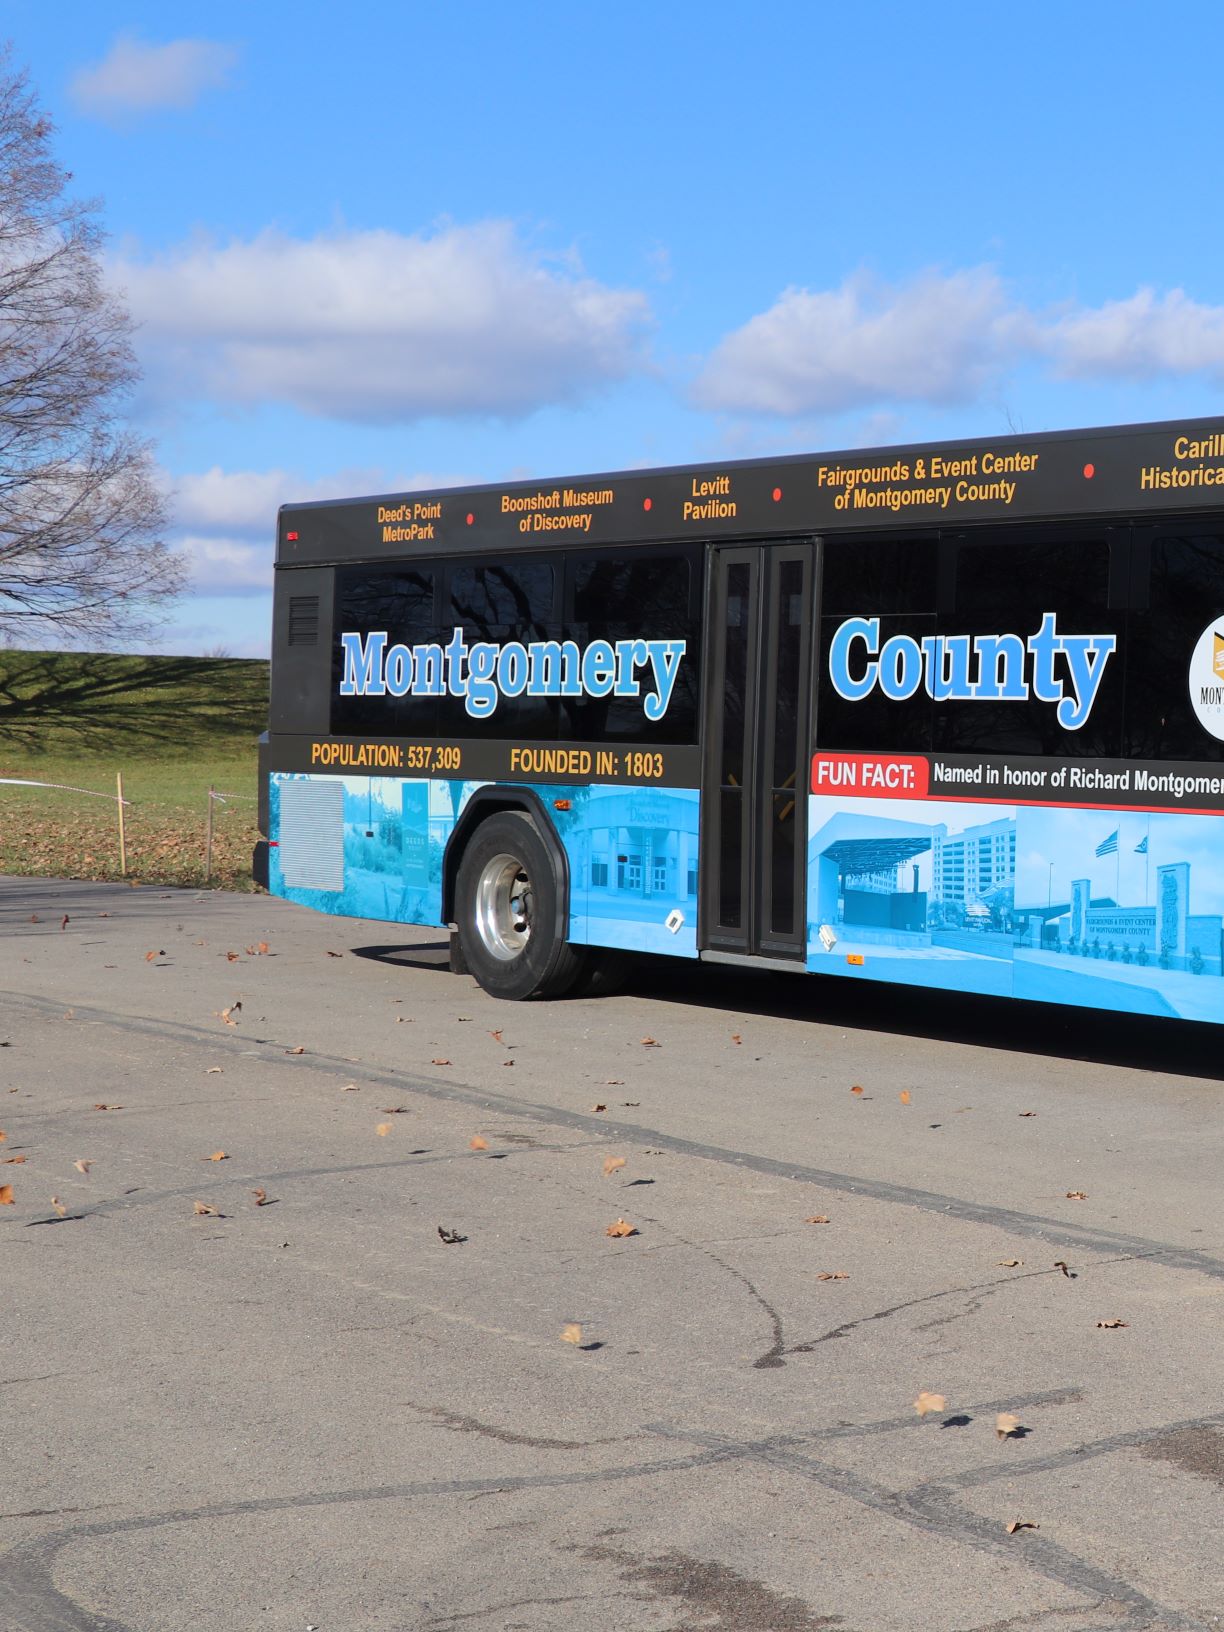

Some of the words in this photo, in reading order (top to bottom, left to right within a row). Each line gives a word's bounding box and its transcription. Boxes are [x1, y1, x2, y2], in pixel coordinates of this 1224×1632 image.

[818, 462, 910, 489] Fairgrounds
[914, 459, 926, 479] &
[930, 455, 977, 479] Event
[981, 452, 1039, 474] Center
[501, 490, 561, 512] Boonshoft
[563, 489, 613, 507] Museum
[692, 476, 730, 497] Levitt
[834, 490, 851, 510] of
[853, 486, 951, 511] Montgomery
[955, 479, 1016, 504] County
[378, 504, 411, 523] Deed's
[414, 502, 441, 520] Point
[519, 515, 533, 532] of
[535, 514, 592, 532] Discovery
[683, 499, 736, 520] Pavilion
[383, 523, 434, 543] MetroPark
[340, 627, 686, 721] Montgomery
[829, 612, 1116, 731] County
[311, 743, 404, 768] POPULATION:
[407, 746, 461, 772] 537,309
[511, 748, 591, 775] FOUNDED
[596, 752, 619, 775] IN:
[624, 752, 664, 778] 1803
[817, 760, 856, 785] FUN
[861, 762, 915, 788] FACT:
[933, 762, 982, 783] Named
[986, 764, 999, 784] in
[1004, 765, 1047, 787] honor
[1051, 766, 1067, 788] of
[1069, 767, 1130, 790] Richard
